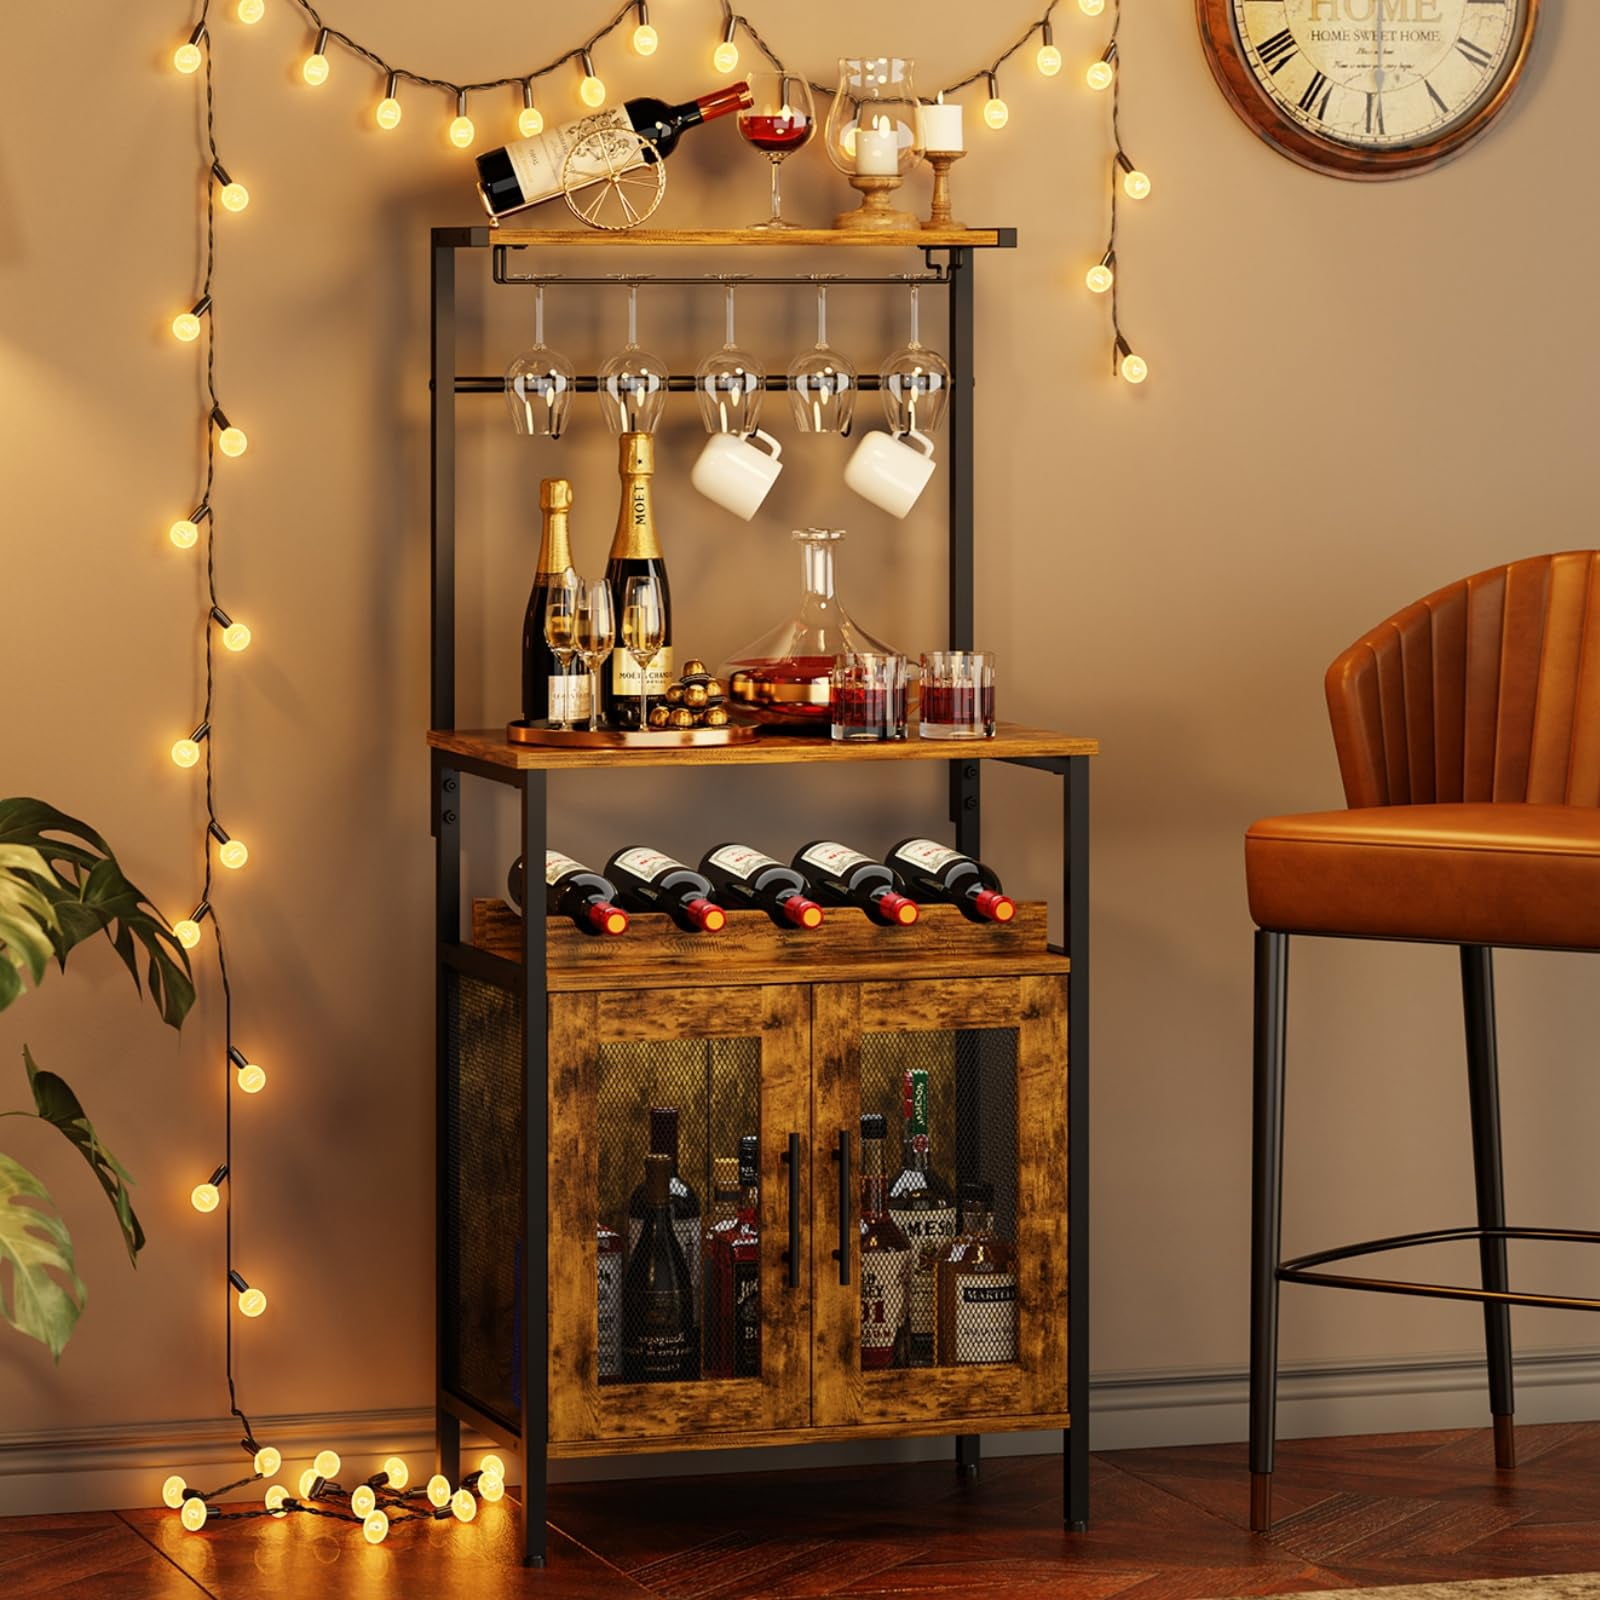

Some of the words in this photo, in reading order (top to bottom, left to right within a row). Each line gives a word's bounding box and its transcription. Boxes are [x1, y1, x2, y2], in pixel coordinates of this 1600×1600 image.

[1311, 30, 1351, 41] HOME
[1353, 30, 1397, 41] SWEET
[1400, 30, 1440, 41] HOME
